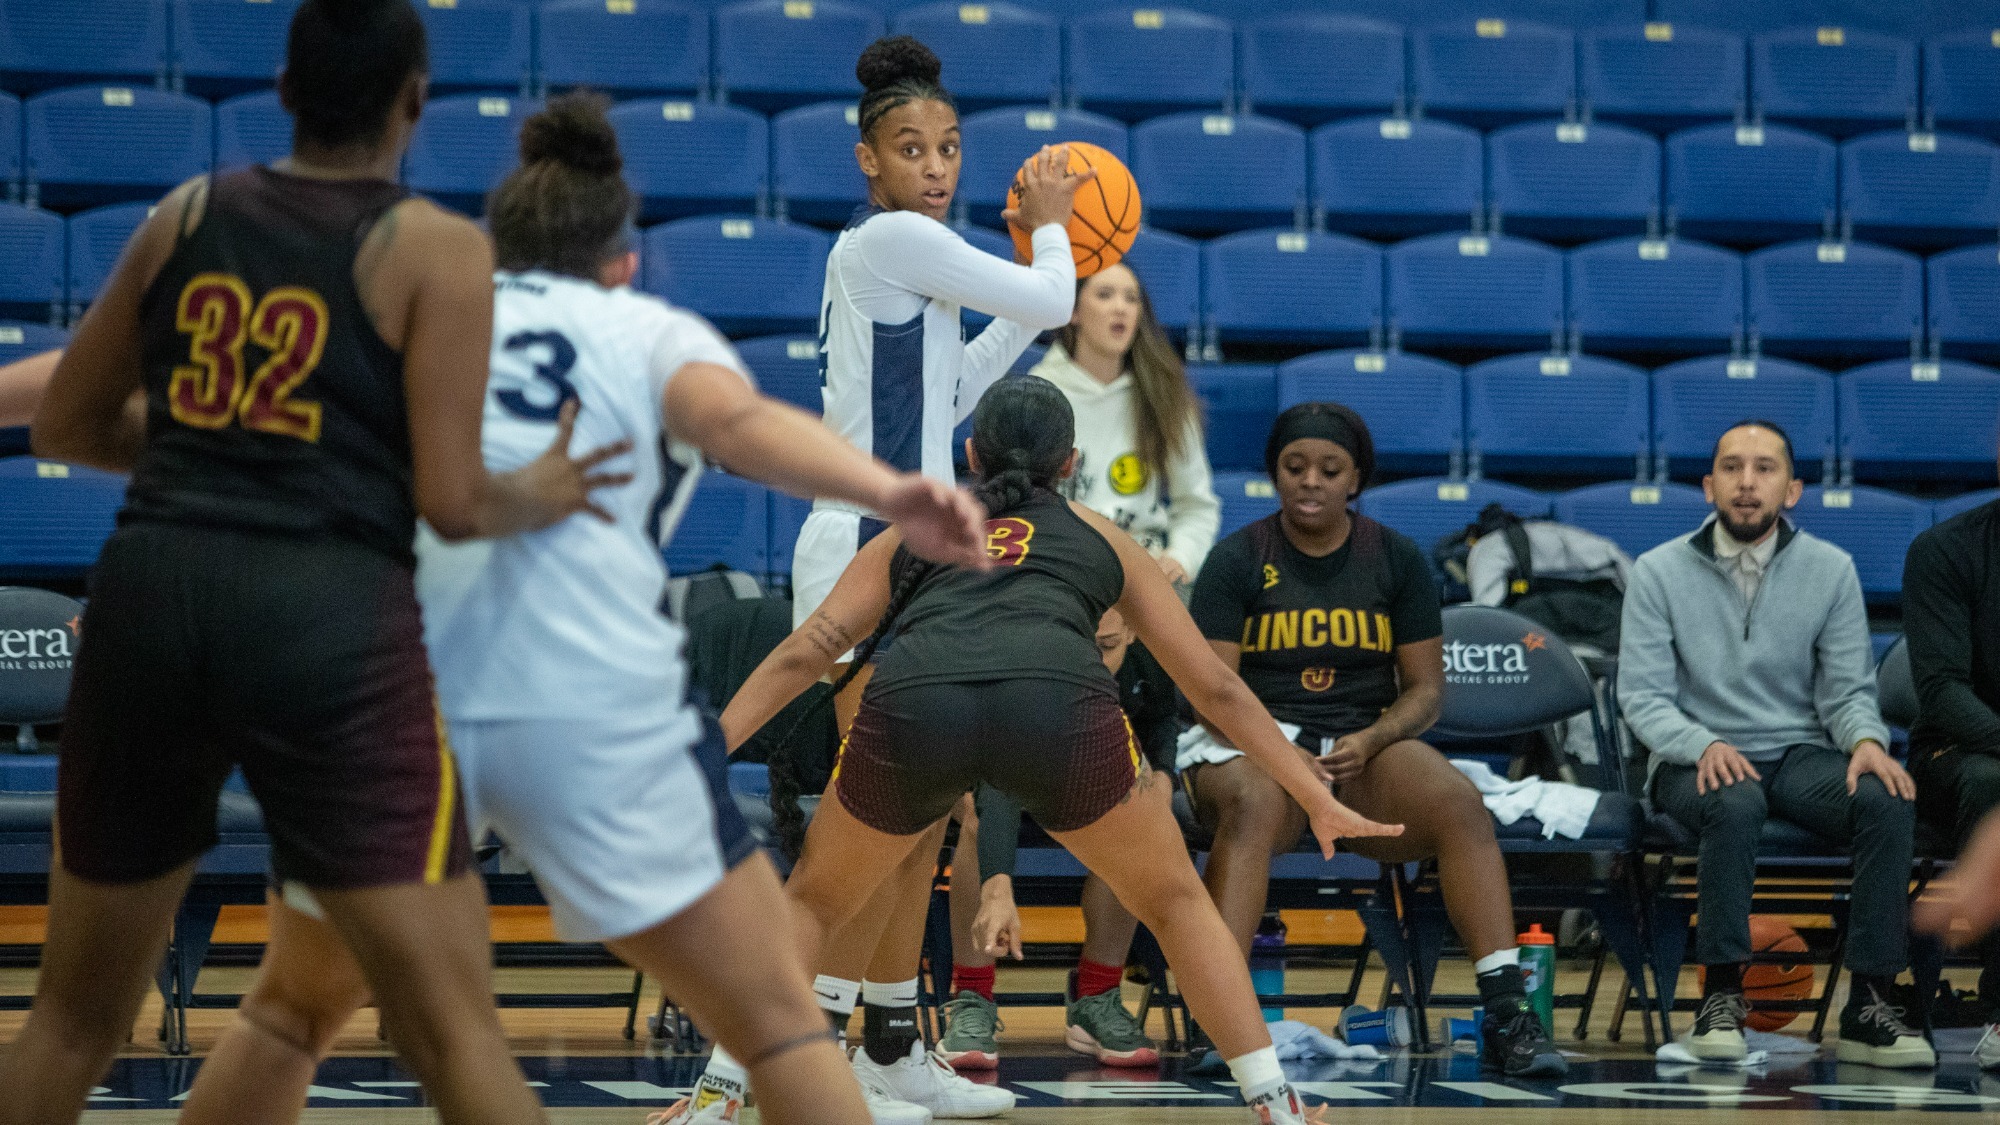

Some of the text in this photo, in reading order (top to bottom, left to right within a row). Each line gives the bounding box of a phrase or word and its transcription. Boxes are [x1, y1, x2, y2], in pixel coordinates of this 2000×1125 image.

[168, 273, 330, 444] 32
[494, 328, 583, 422] 3
[984, 516, 1035, 567] 3
[1240, 607, 1393, 653] LINCOLN
